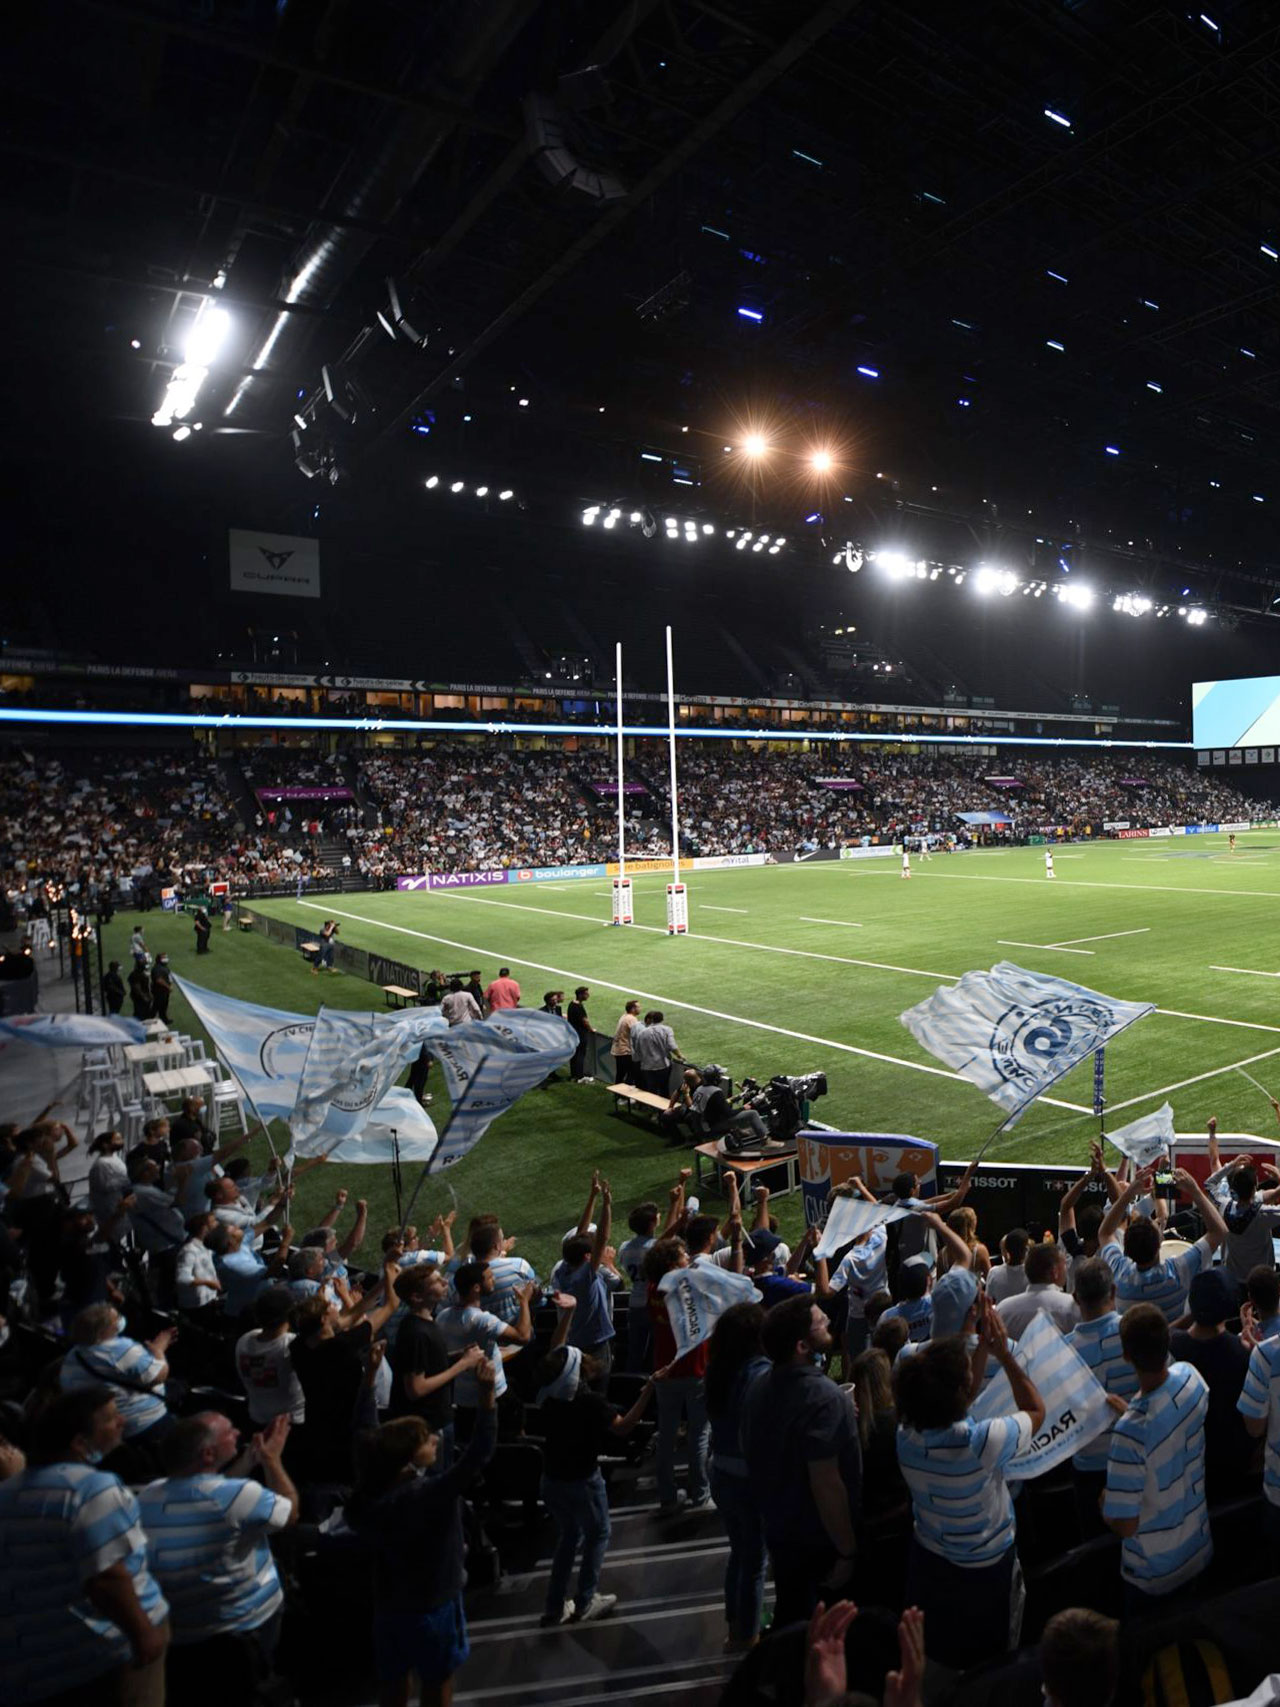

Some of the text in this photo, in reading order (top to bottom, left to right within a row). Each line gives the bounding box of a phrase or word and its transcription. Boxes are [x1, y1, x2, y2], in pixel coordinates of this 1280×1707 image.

[1118, 830, 1148, 838] LARINS
[433, 872, 504, 886] NATIXIS
[536, 866, 600, 880] boulanger
[383, 961, 419, 989] NATIXIS
[969, 1177, 1018, 1189] TISSOT
